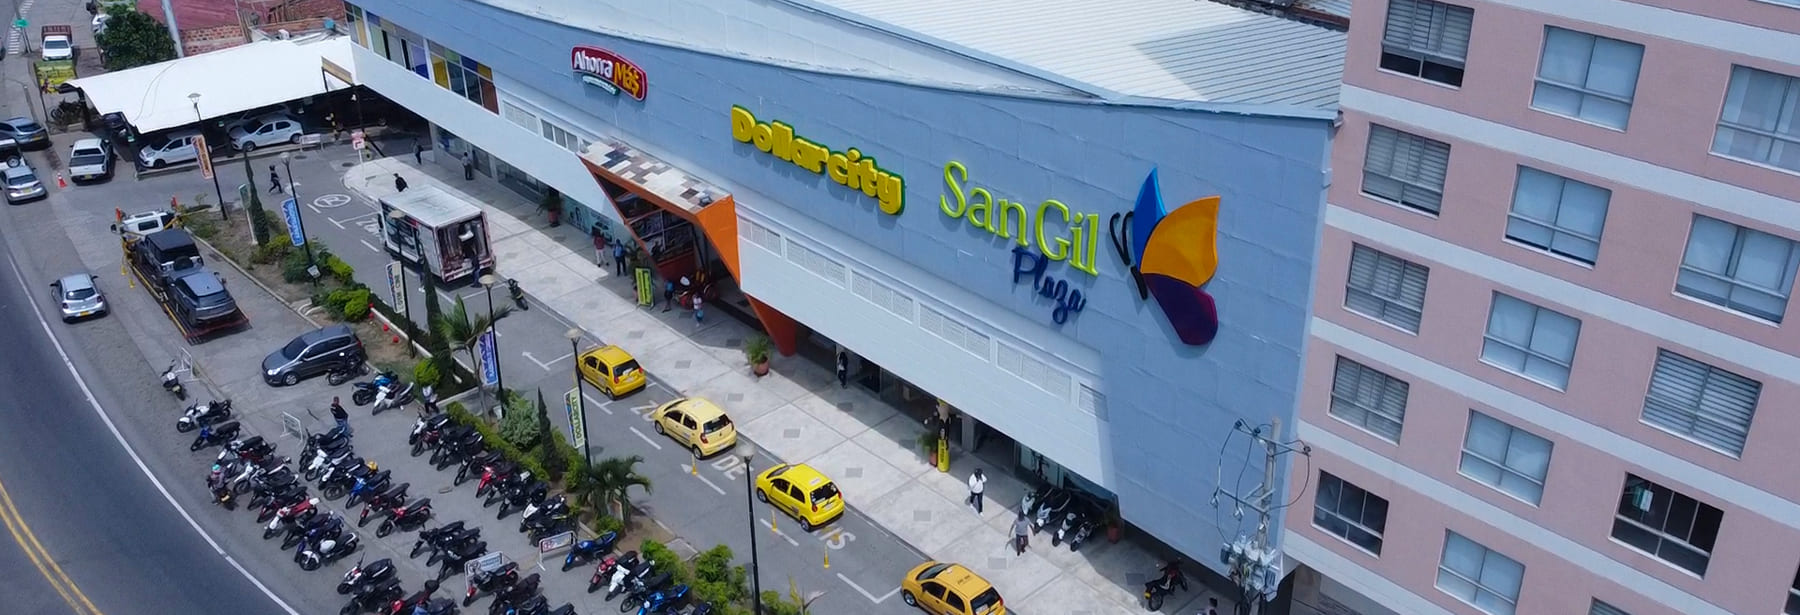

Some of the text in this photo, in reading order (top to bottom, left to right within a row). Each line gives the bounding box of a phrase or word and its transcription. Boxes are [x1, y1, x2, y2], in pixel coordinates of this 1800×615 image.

[574, 50, 613, 79] Ahorra
[731, 104, 905, 215] Dollarcity
[939, 160, 1099, 276] San Gil
[1011, 246, 1087, 325] Plaza
